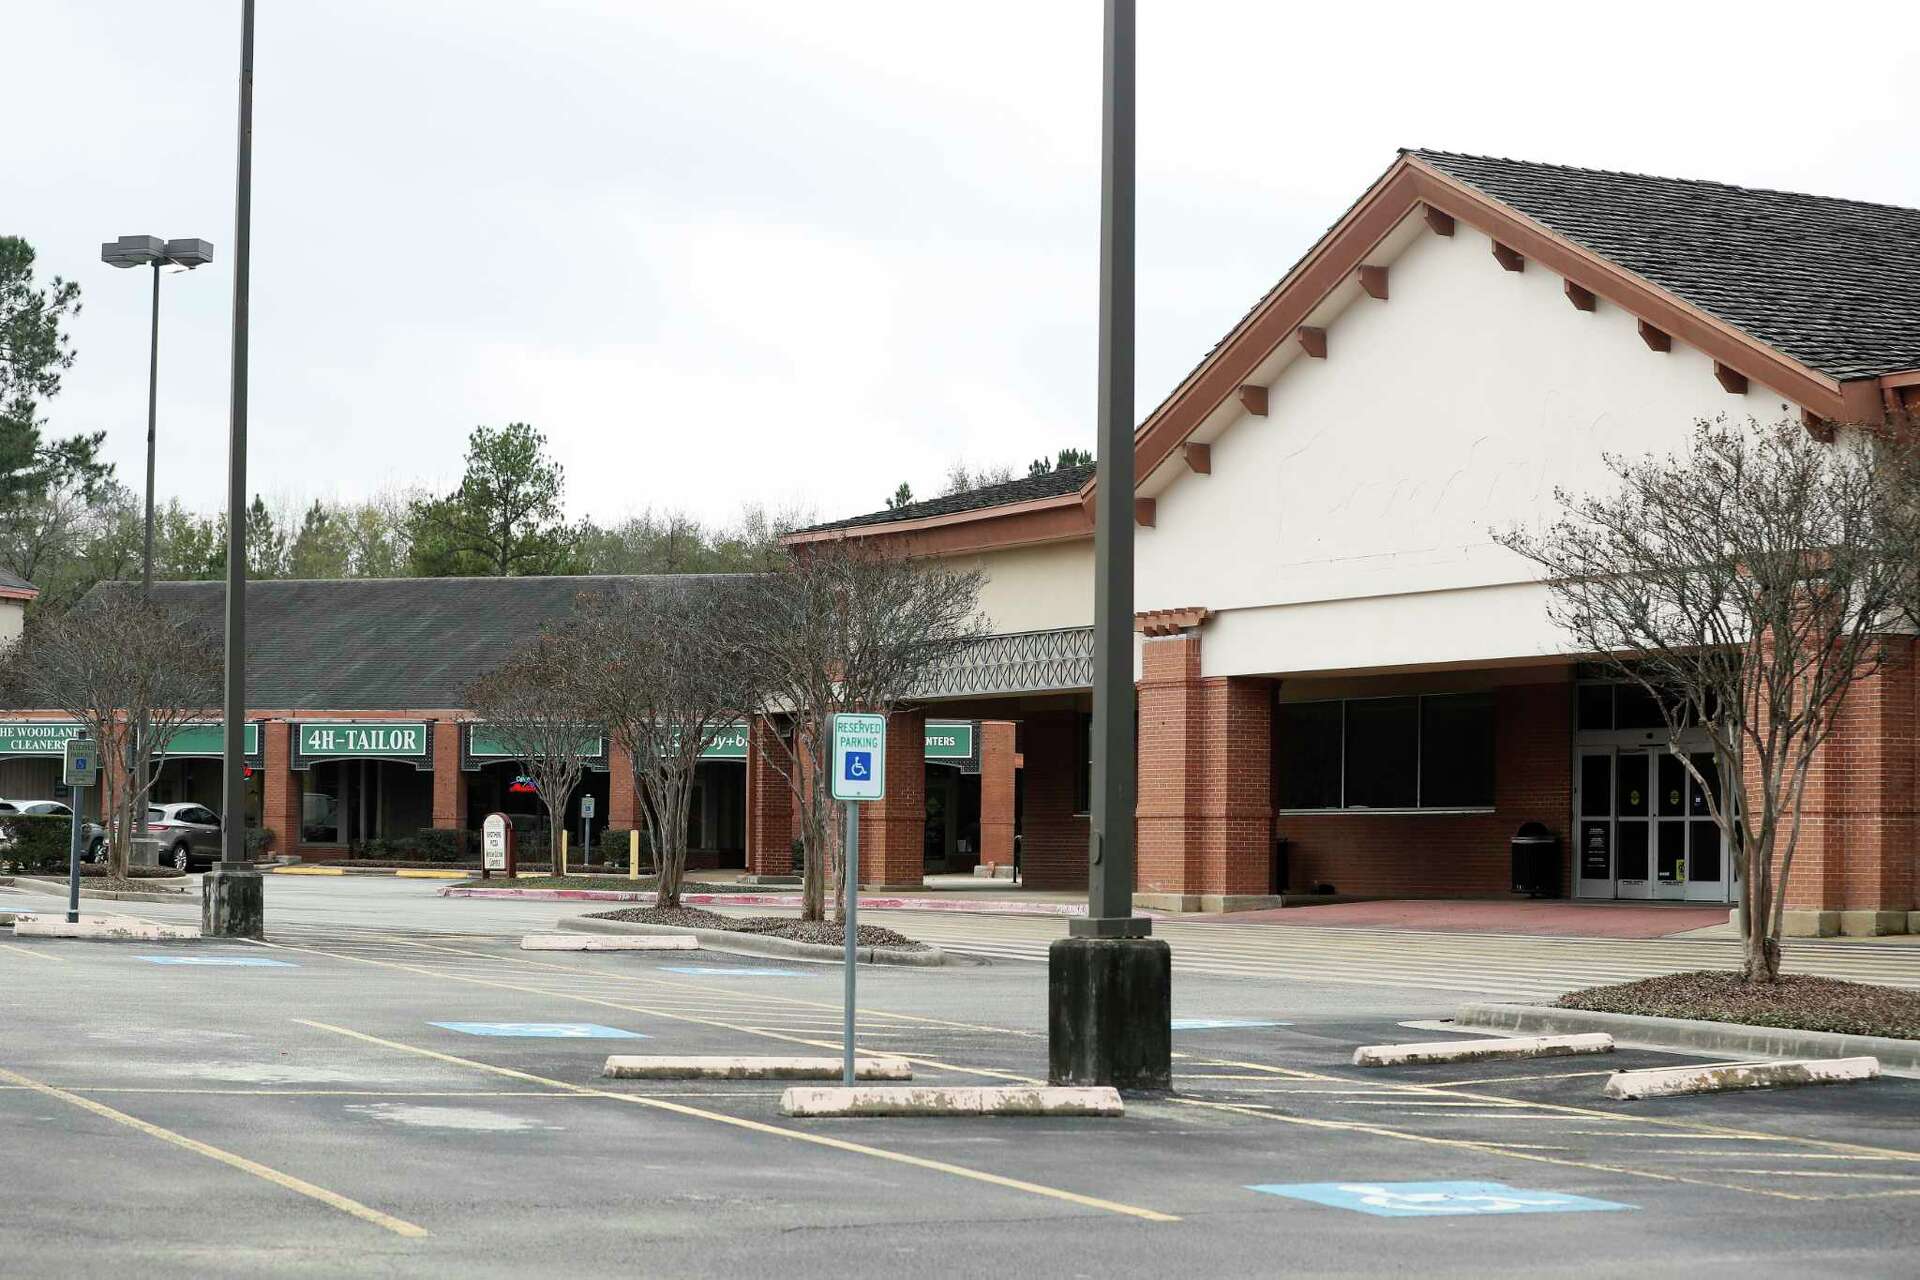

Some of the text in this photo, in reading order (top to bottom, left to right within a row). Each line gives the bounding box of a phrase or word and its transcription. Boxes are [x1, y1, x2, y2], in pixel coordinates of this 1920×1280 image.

[837, 723, 881, 733] RESERVED
[11, 739, 66, 750] CLEANERS
[308, 729, 417, 750] 4H-TAILOR
[841, 736, 878, 748] PARKING
[924, 736, 956, 746] NTERS
